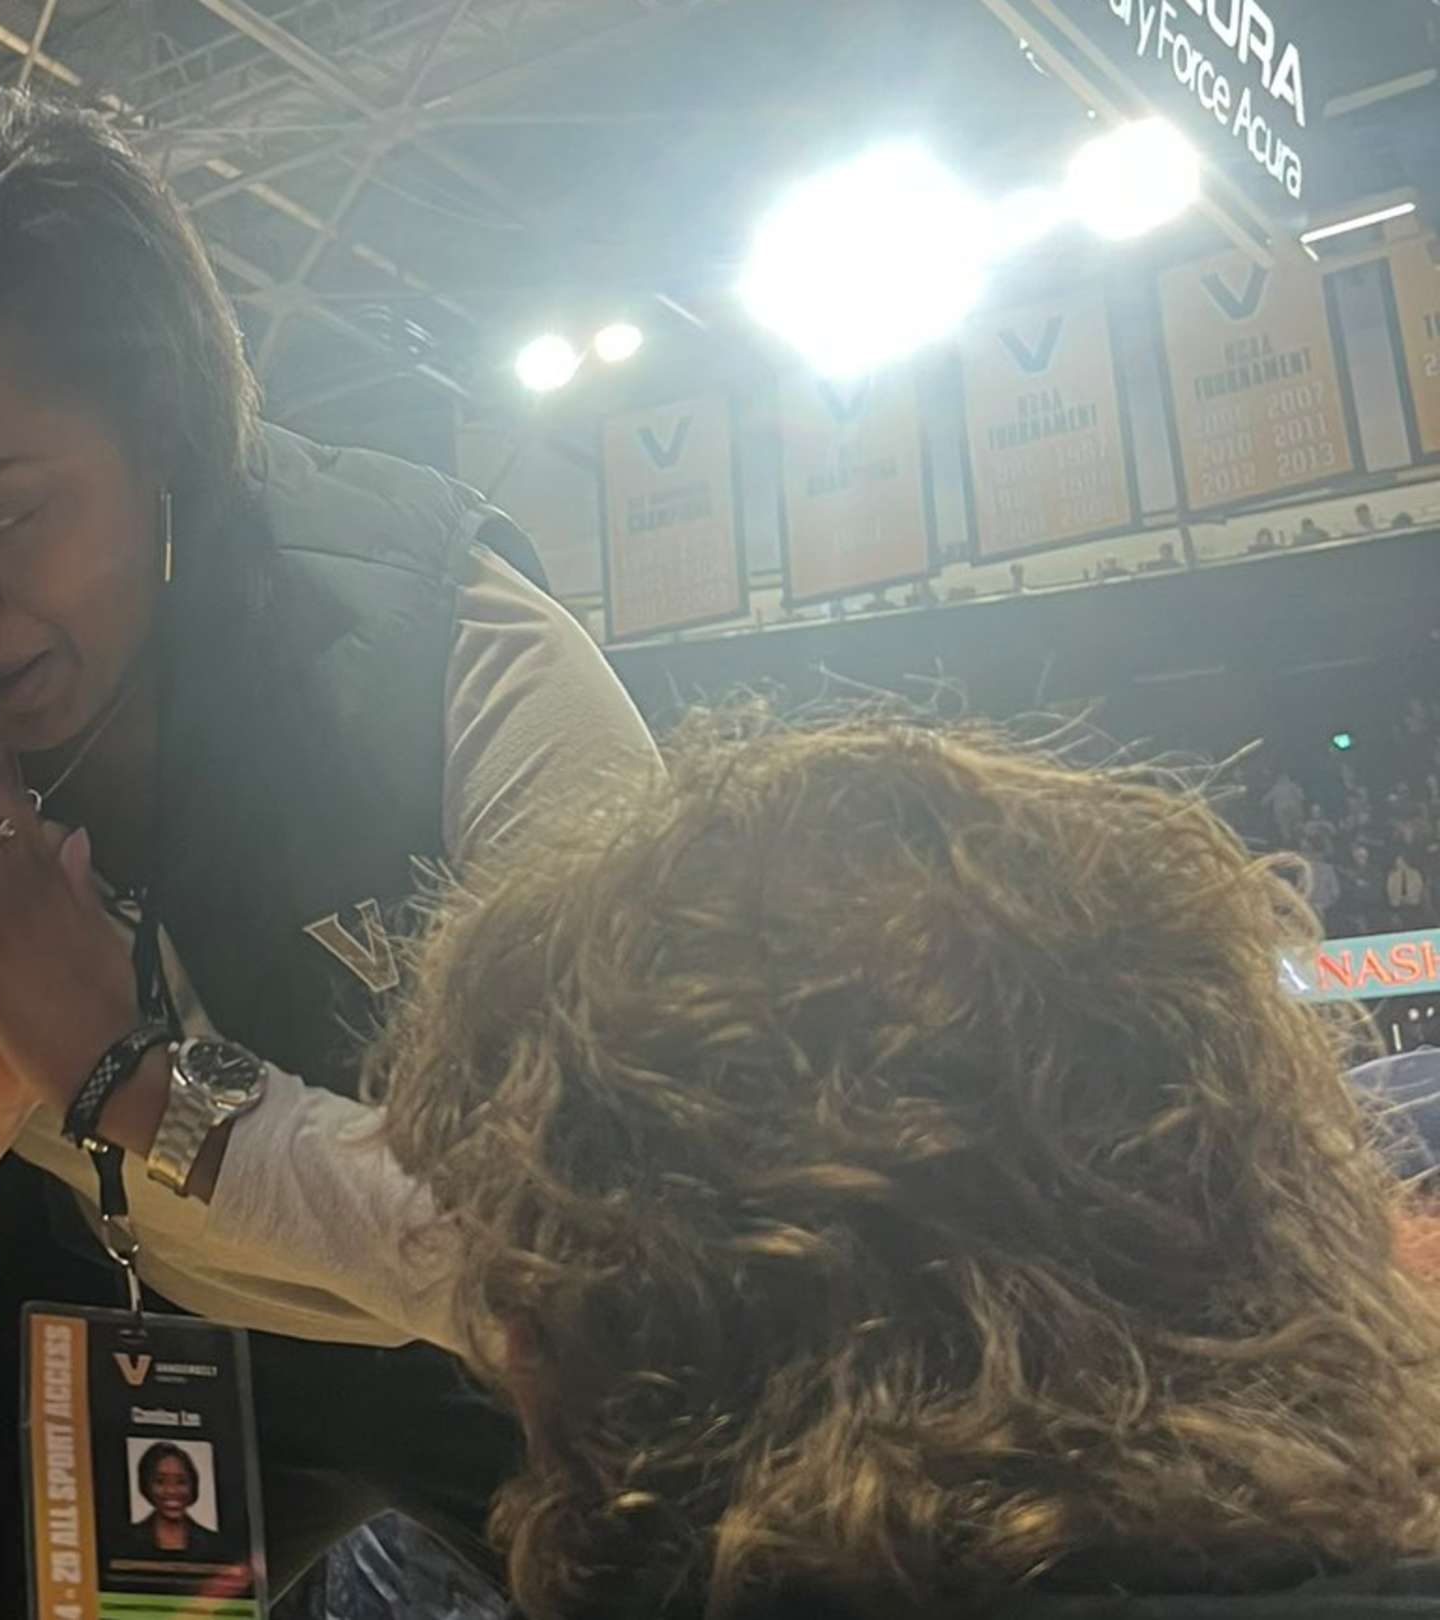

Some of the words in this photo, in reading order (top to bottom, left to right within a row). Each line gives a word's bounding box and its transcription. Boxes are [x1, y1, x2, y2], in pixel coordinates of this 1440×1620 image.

[1184, 0, 1306, 127] URA
[1157, 0, 1231, 125] Force
[1232, 87, 1301, 200] Acura
[1200, 258, 1271, 321] V
[997, 313, 1065, 374] V
[1194, 346, 1314, 401] TOURNAMENT
[637, 415, 693, 469] V
[1271, 415, 1329, 448] 2011
[1277, 442, 1337, 477] 2013
[302, 897, 400, 993] V
[43, 1325, 73, 1419] ACCESS
[112, 1352, 153, 1386] V
[44, 1421, 77, 1501] SPORT
[48, 1505, 79, 1547] ALL
